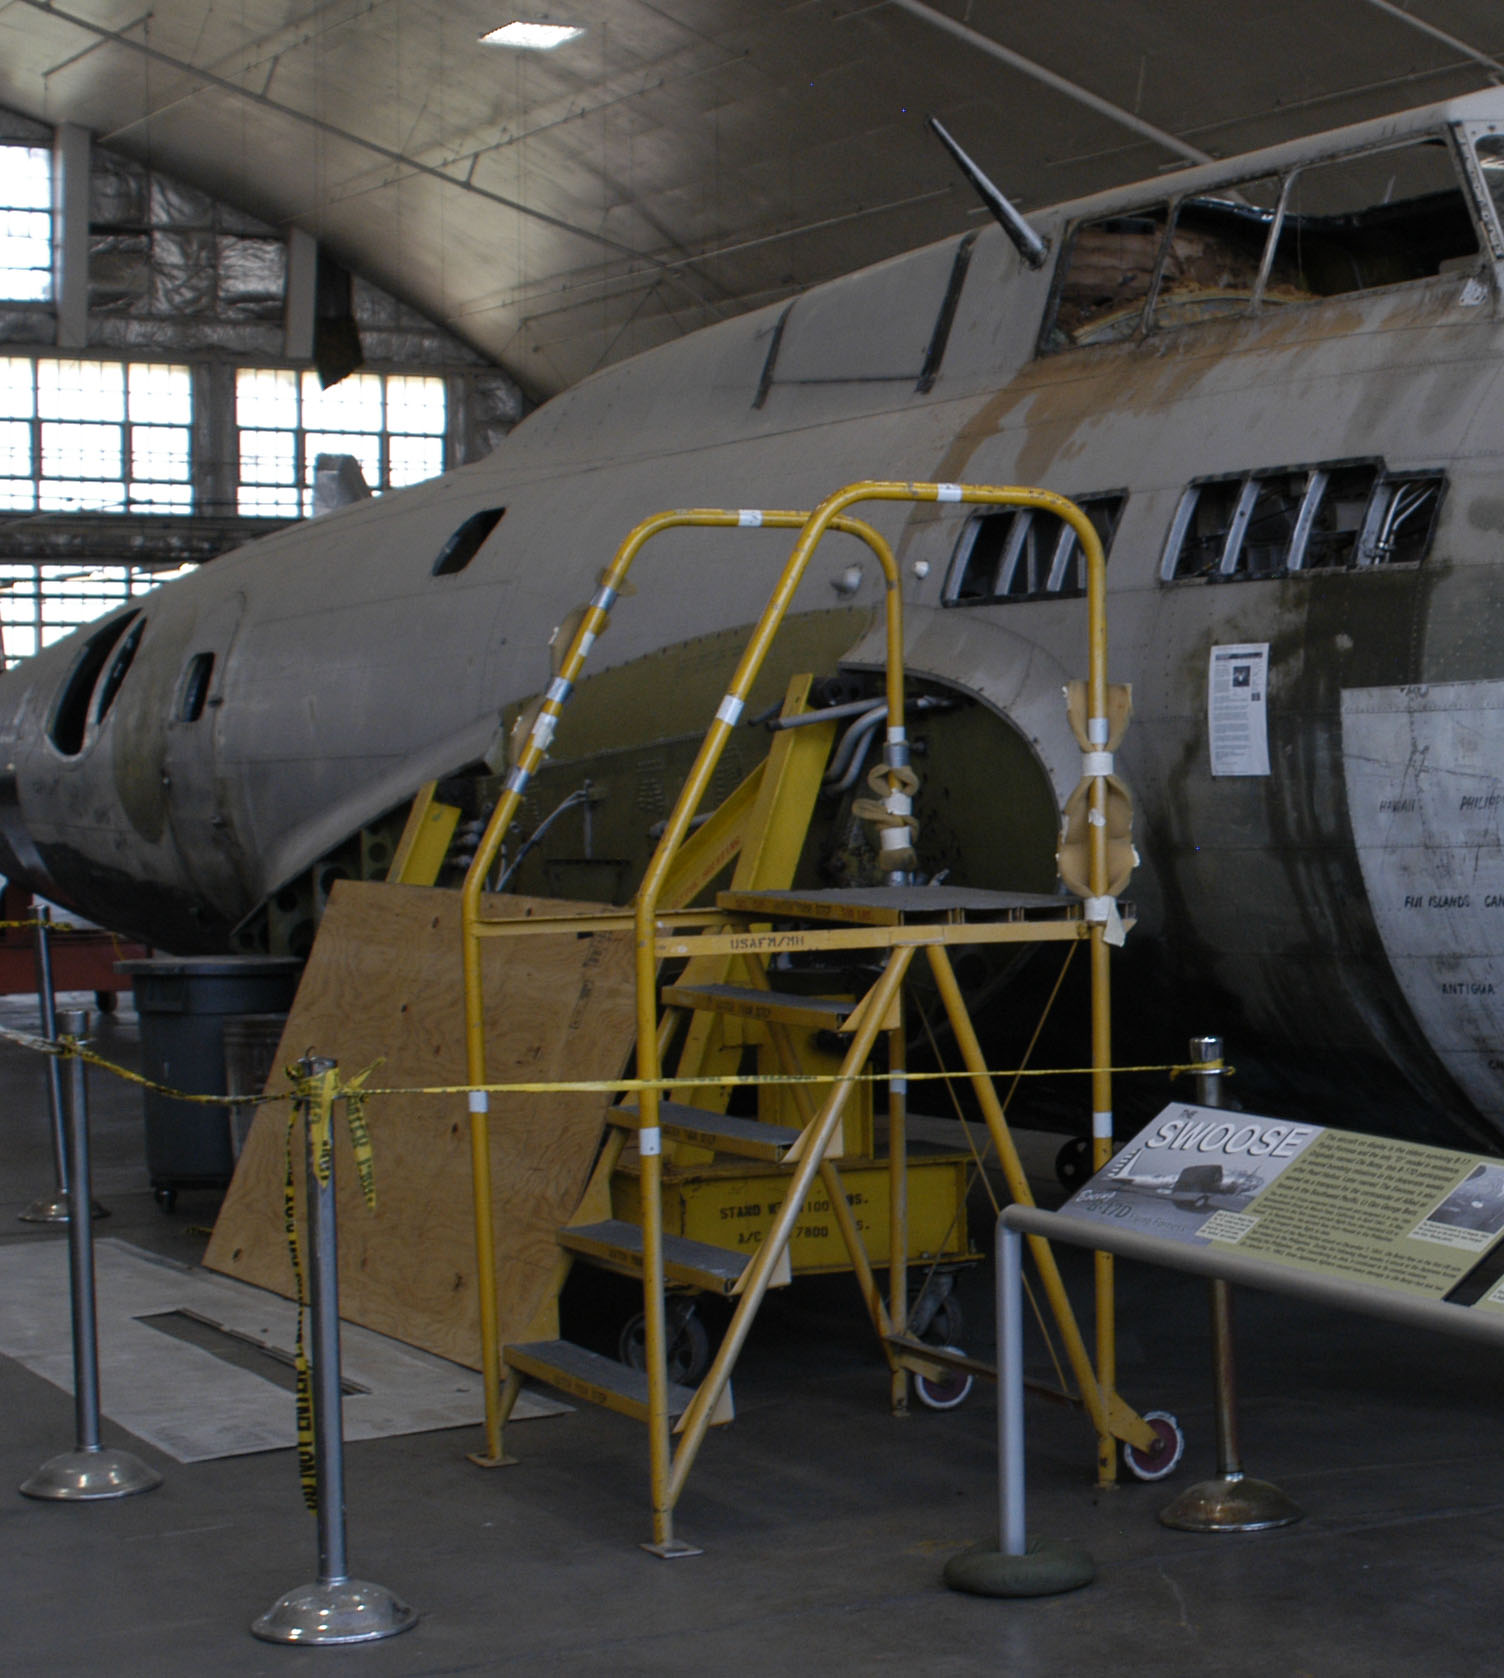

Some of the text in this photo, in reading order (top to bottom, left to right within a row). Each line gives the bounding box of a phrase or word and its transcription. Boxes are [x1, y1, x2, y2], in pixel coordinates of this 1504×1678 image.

[1428, 894, 1472, 909] ISLANDS
[1442, 982, 1496, 997] ANTIGUA
[1145, 1119, 1314, 1158] SWOOSE
[720, 1203, 762, 1221] STAND
[738, 1231, 763, 1245] A/C
